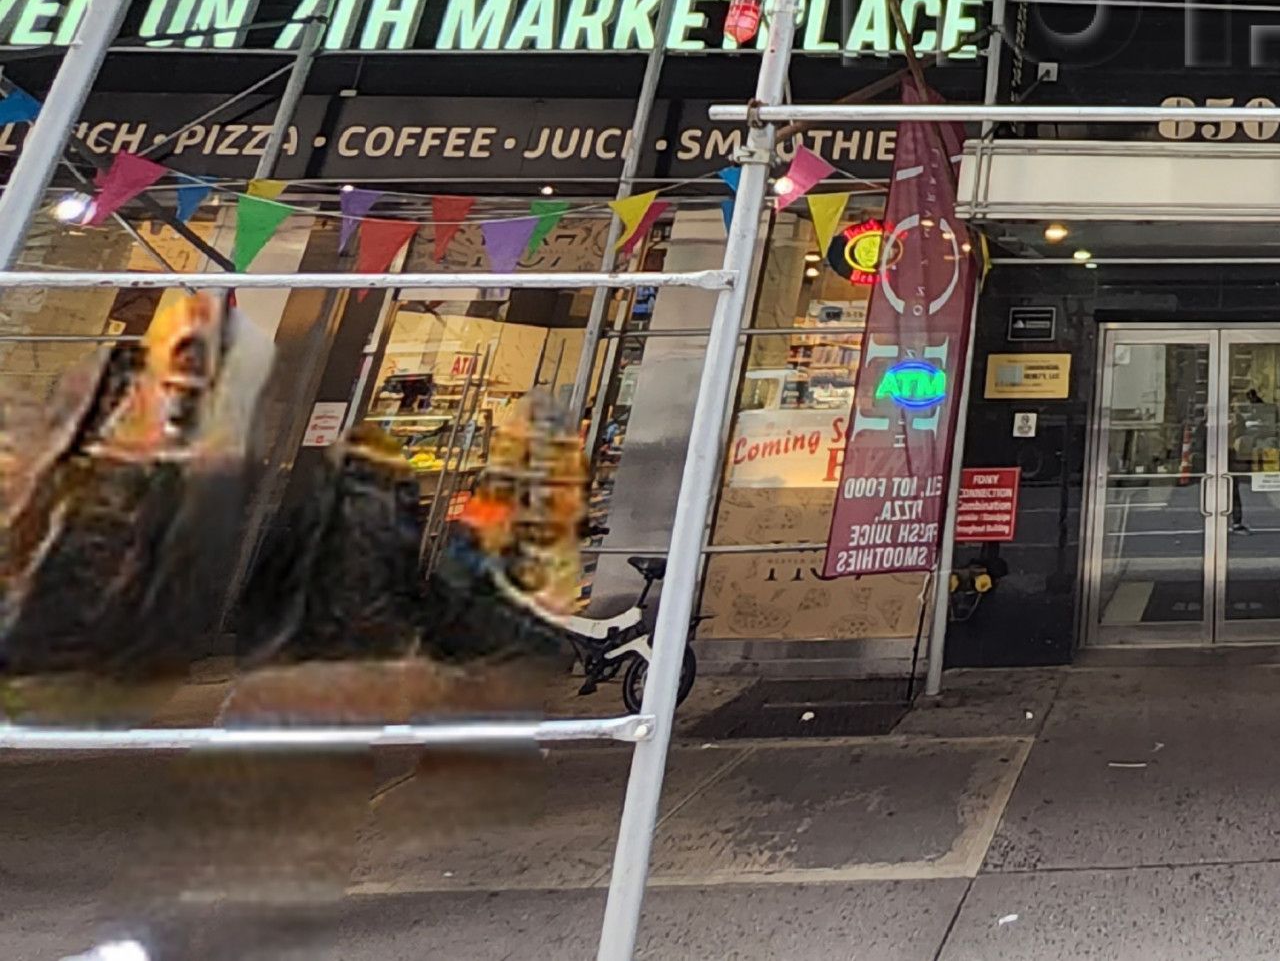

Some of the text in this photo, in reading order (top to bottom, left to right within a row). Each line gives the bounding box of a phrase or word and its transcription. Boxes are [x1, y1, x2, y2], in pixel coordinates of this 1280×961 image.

[1158, 96, 1280, 140] 850
[0, 122, 147, 154] LCH
[174, 125, 298, 156] PIZZA
[338, 126, 497, 157] COFFEE
[677, 128, 898, 161] SMOTHIE
[875, 369, 947, 399] ATM
[733, 429, 822, 465] Coming
